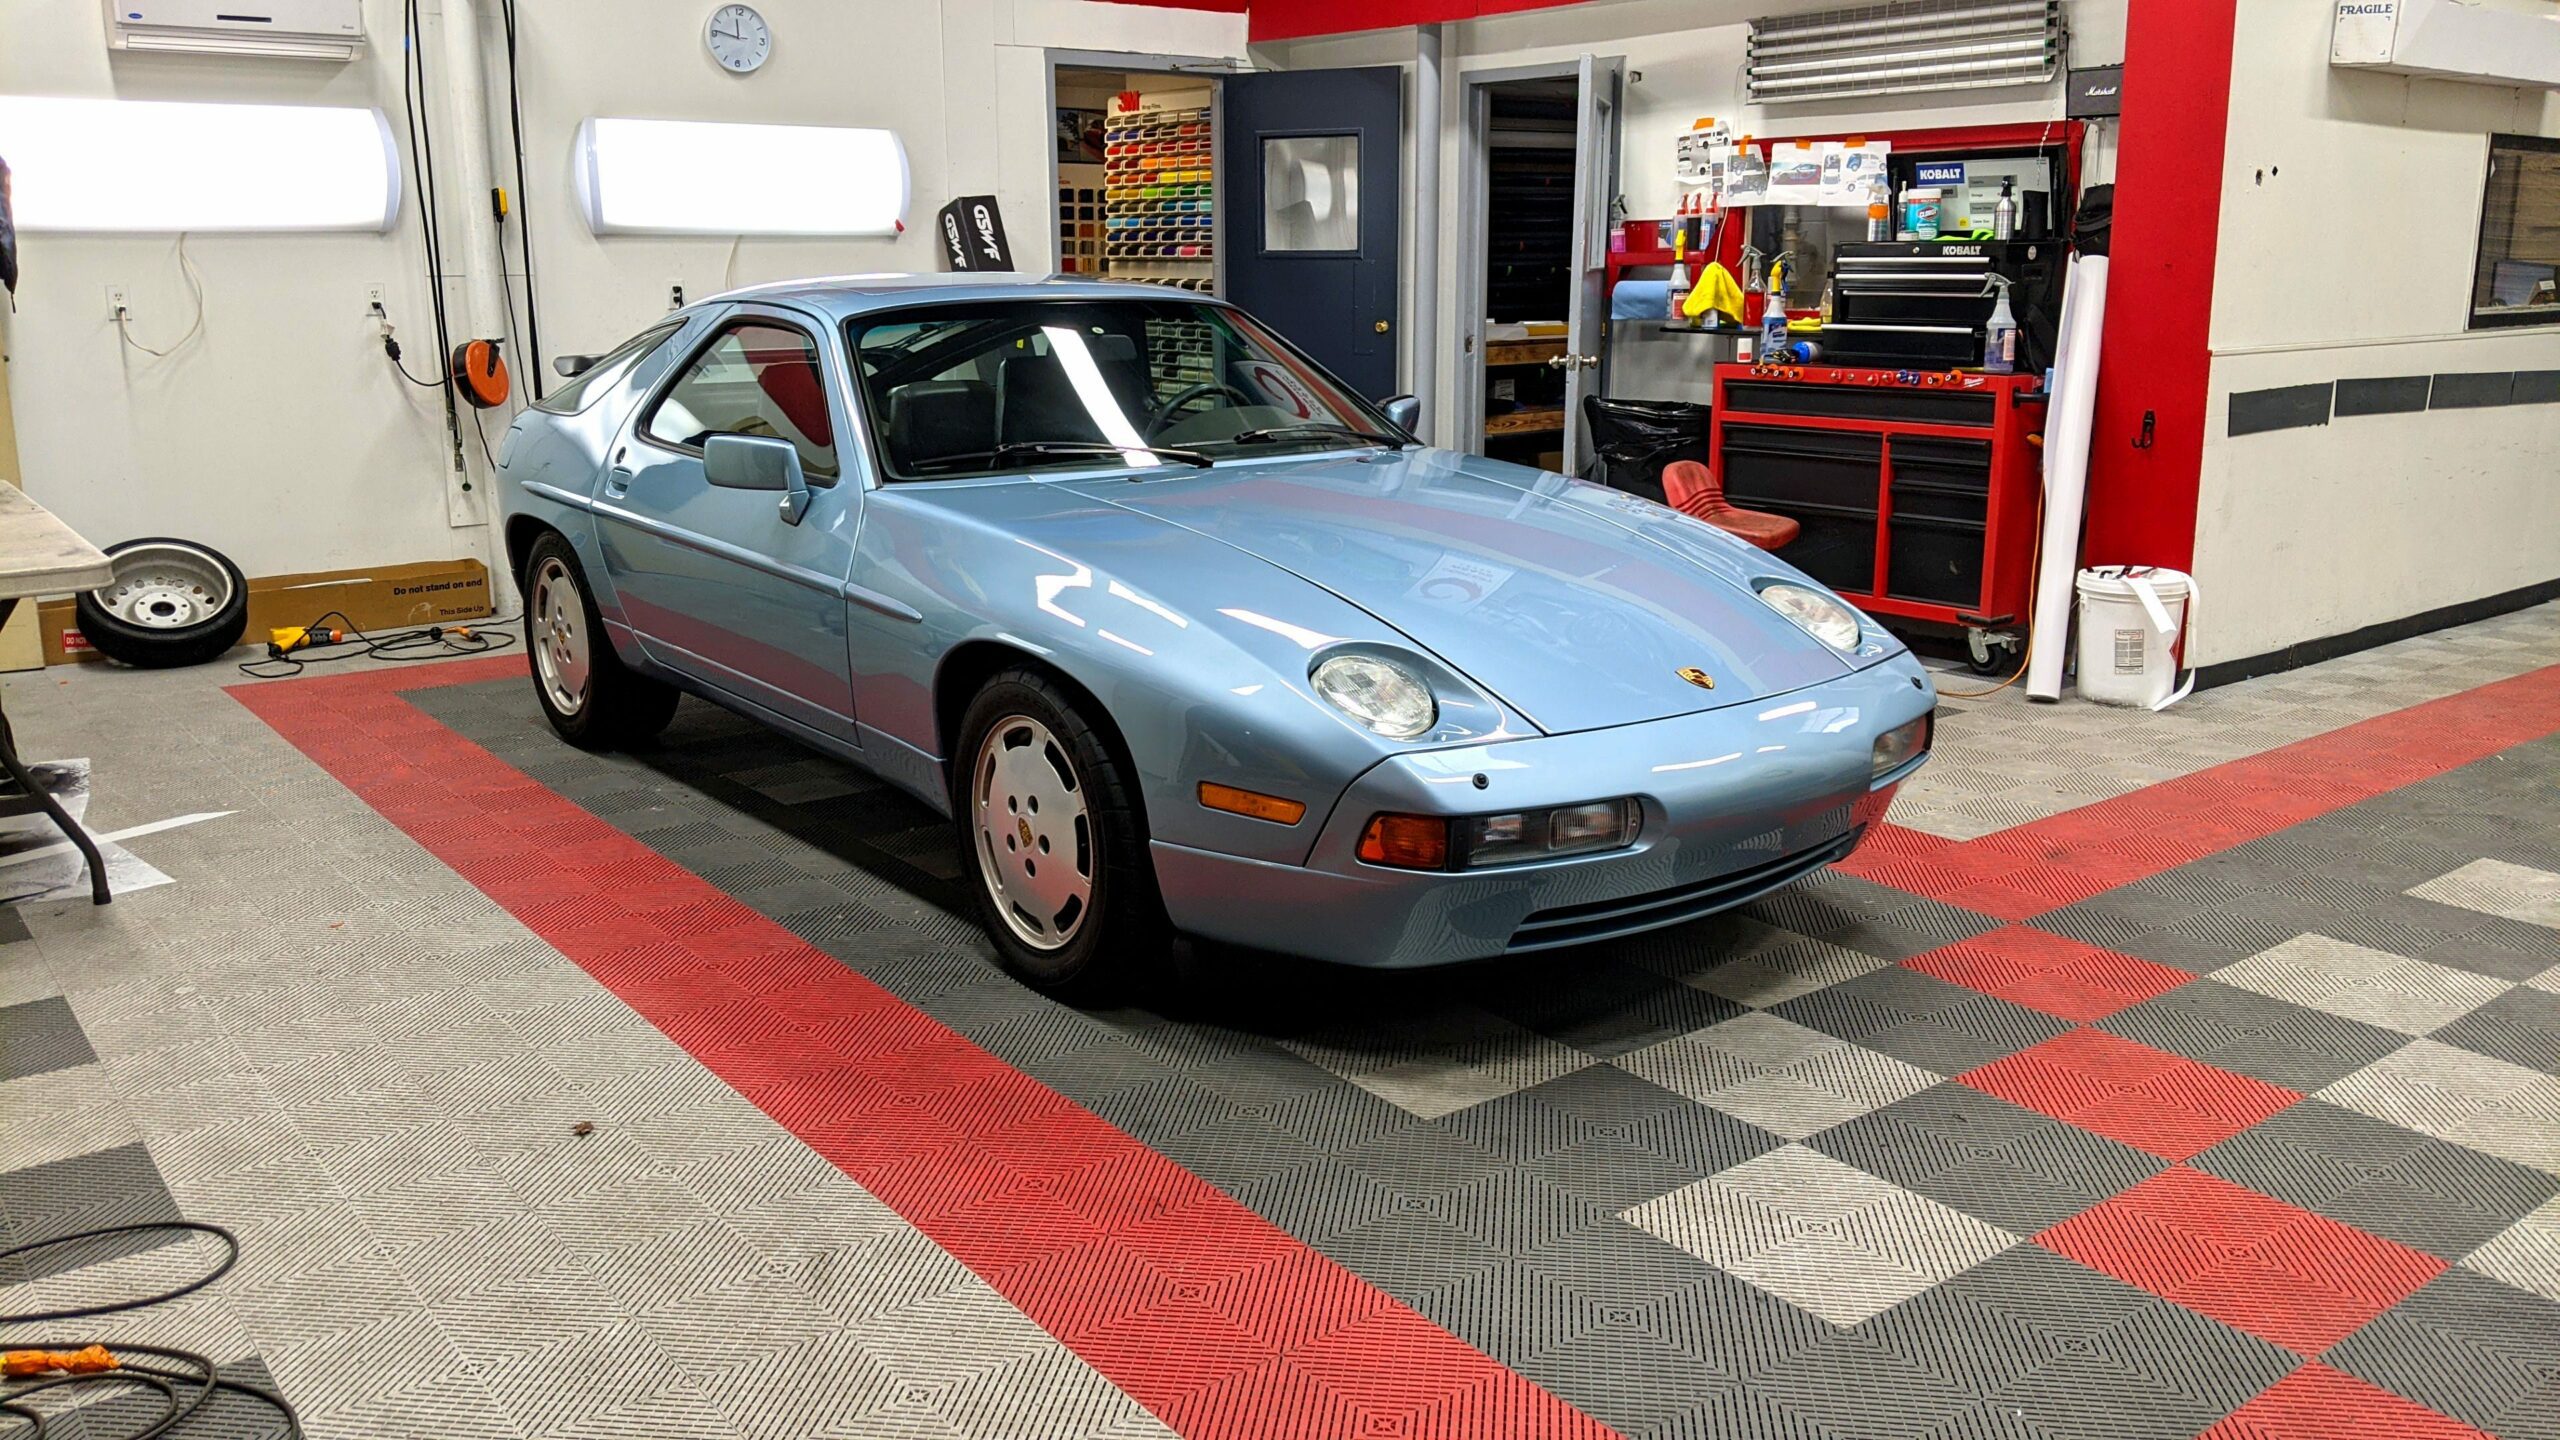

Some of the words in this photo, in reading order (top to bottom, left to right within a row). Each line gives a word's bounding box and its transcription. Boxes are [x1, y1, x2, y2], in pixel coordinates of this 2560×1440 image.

[735, 8, 744, 16] 12
[2339, 4, 2393, 15] FRAGILE
[759, 38, 766, 46] 3
[734, 60, 740, 68] 6
[1118, 90, 1140, 112] 3M
[1919, 168, 1961, 180] KOBALT
[973, 204, 1001, 262] GSWF
[945, 213, 967, 269] GSWF
[1942, 245, 1982, 256] KOBALT
[394, 587, 406, 595] Do
[425, 582, 451, 592] stand
[466, 579, 482, 587] end
[439, 608, 455, 616] This
[456, 606, 472, 614] Side
[473, 605, 484, 613] Up
